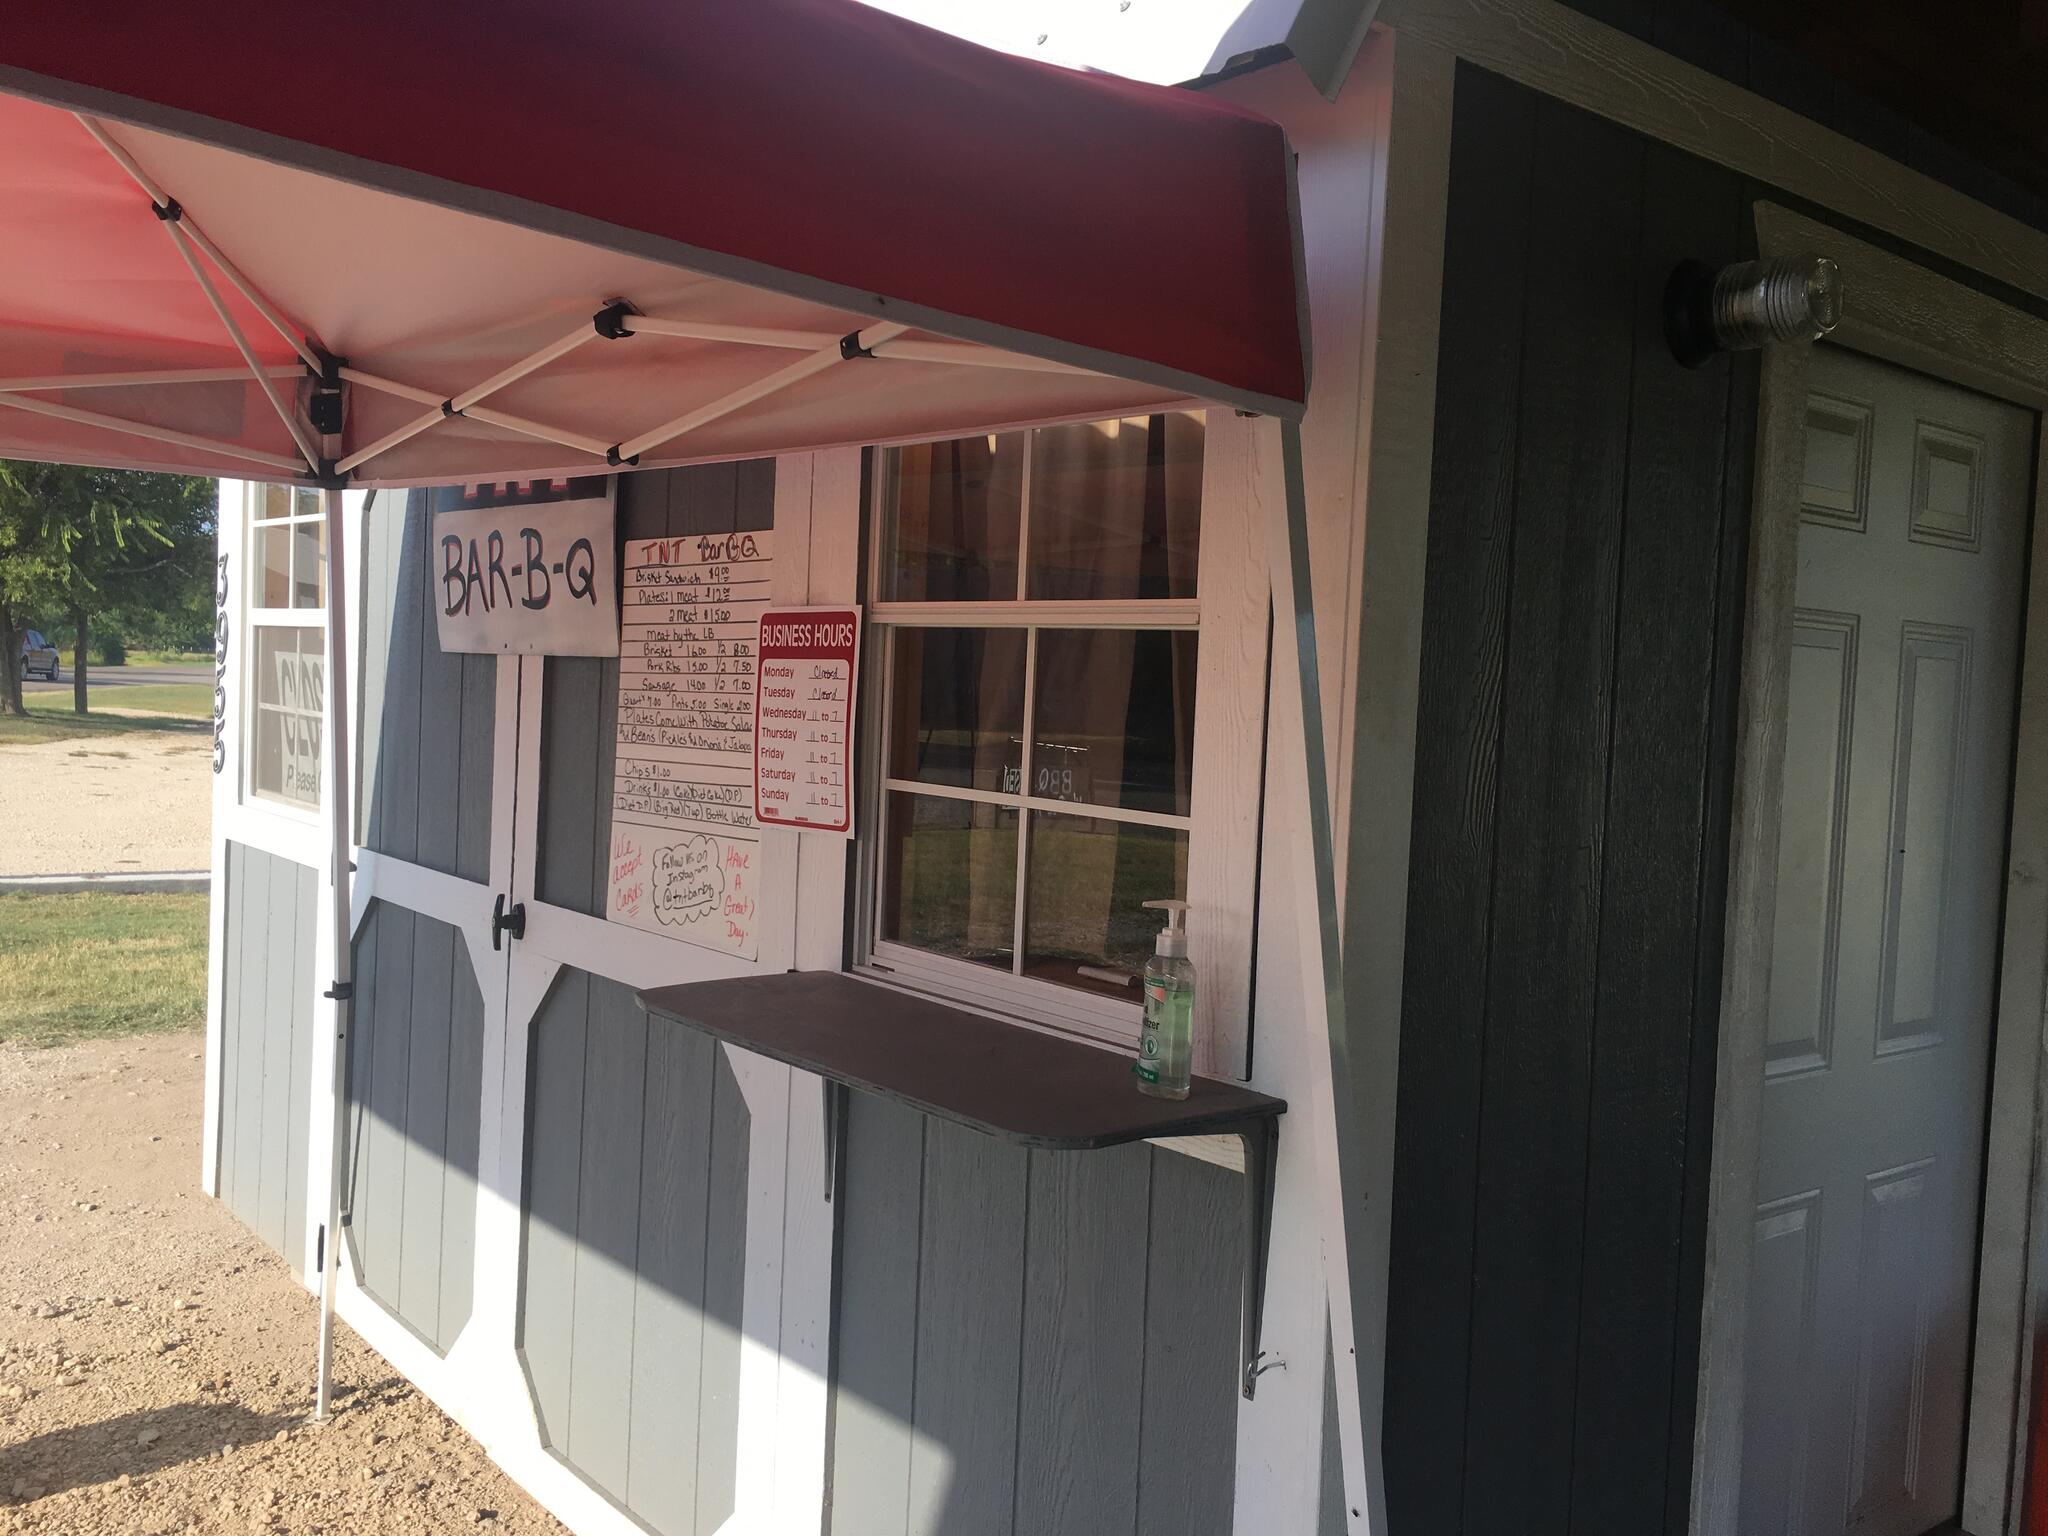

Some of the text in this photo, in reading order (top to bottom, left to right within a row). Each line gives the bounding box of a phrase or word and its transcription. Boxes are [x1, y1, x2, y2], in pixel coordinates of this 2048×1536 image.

[642, 538, 686, 565] TNT
[442, 528, 597, 617] BAR-B-Q
[703, 627, 715, 639] LB
[761, 623, 854, 647] BUSINESS HOURS
[764, 666, 794, 679] Monday
[763, 686, 796, 700] Tuesday
[762, 706, 807, 721] Wednesday
[821, 712, 829, 722] to
[761, 727, 798, 741] Thursday
[820, 734, 829, 743] to
[761, 747, 785, 761] Friday
[820, 755, 828, 764] to
[624, 759, 650, 779] Chips
[761, 767, 796, 782] Saturday
[820, 776, 828, 785] to
[286, 764, 317, 793] Pease
[761, 787, 790, 802] Sunday
[820, 797, 829, 806] to
[666, 865, 709, 887] Instagram
[734, 873, 743, 891] A
